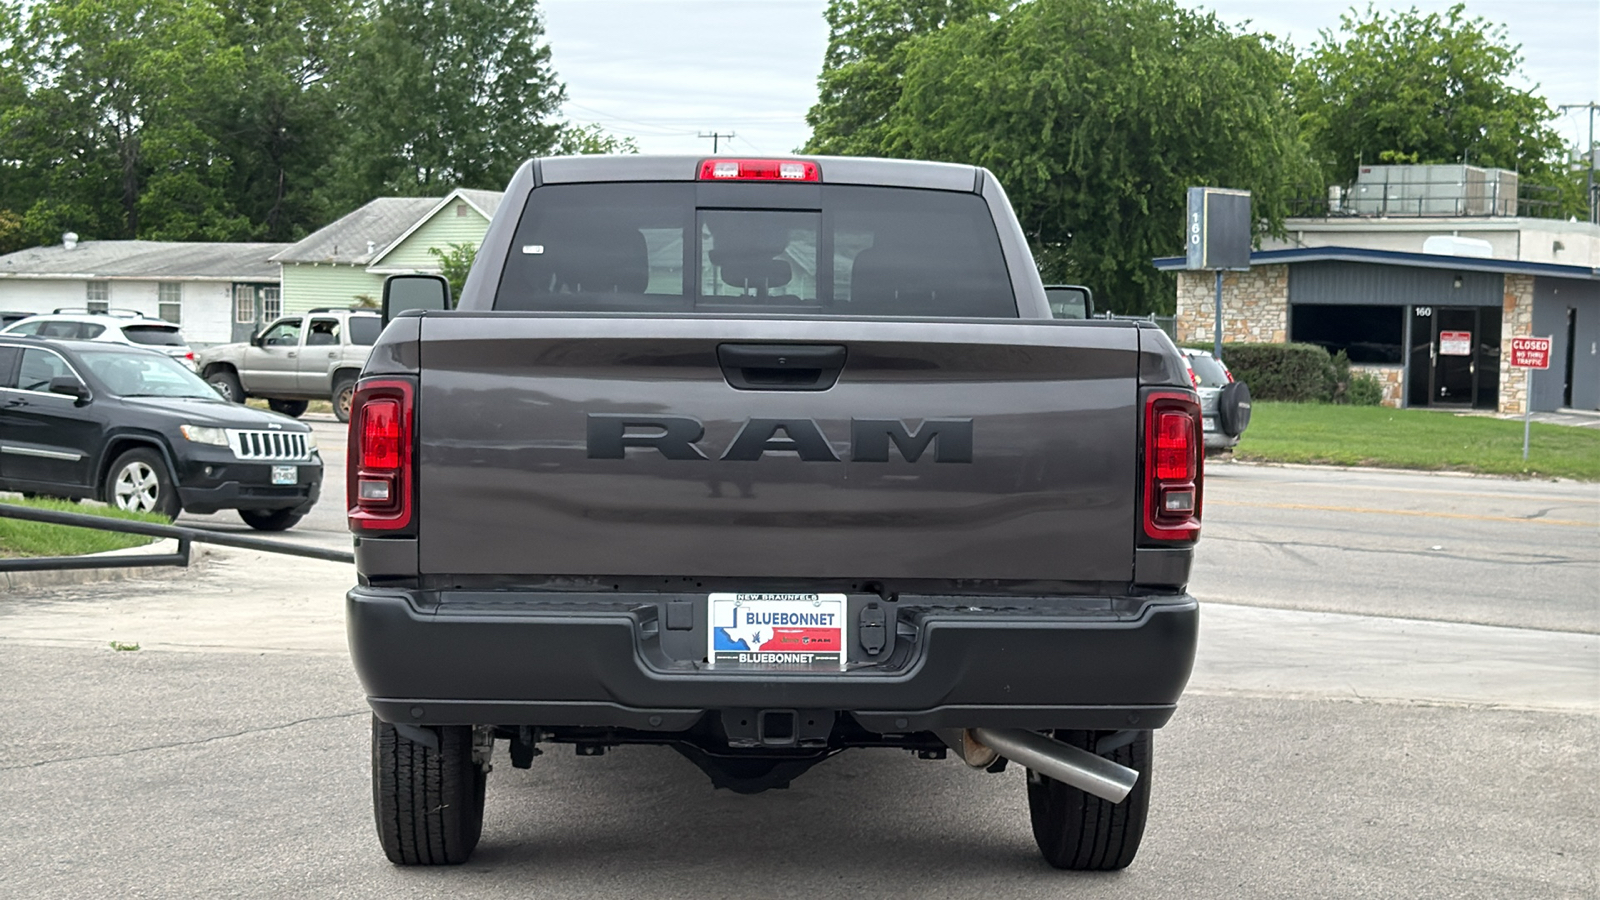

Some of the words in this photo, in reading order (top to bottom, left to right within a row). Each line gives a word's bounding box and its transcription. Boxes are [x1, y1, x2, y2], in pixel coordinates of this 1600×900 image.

[1191, 212, 1200, 245] 160
[1416, 306, 1432, 317] 160
[1513, 340, 1548, 351] CLOSED
[586, 412, 974, 464] RAM
[746, 612, 835, 626] BLUEBONNET
[739, 653, 814, 663] BLUEBONNET
